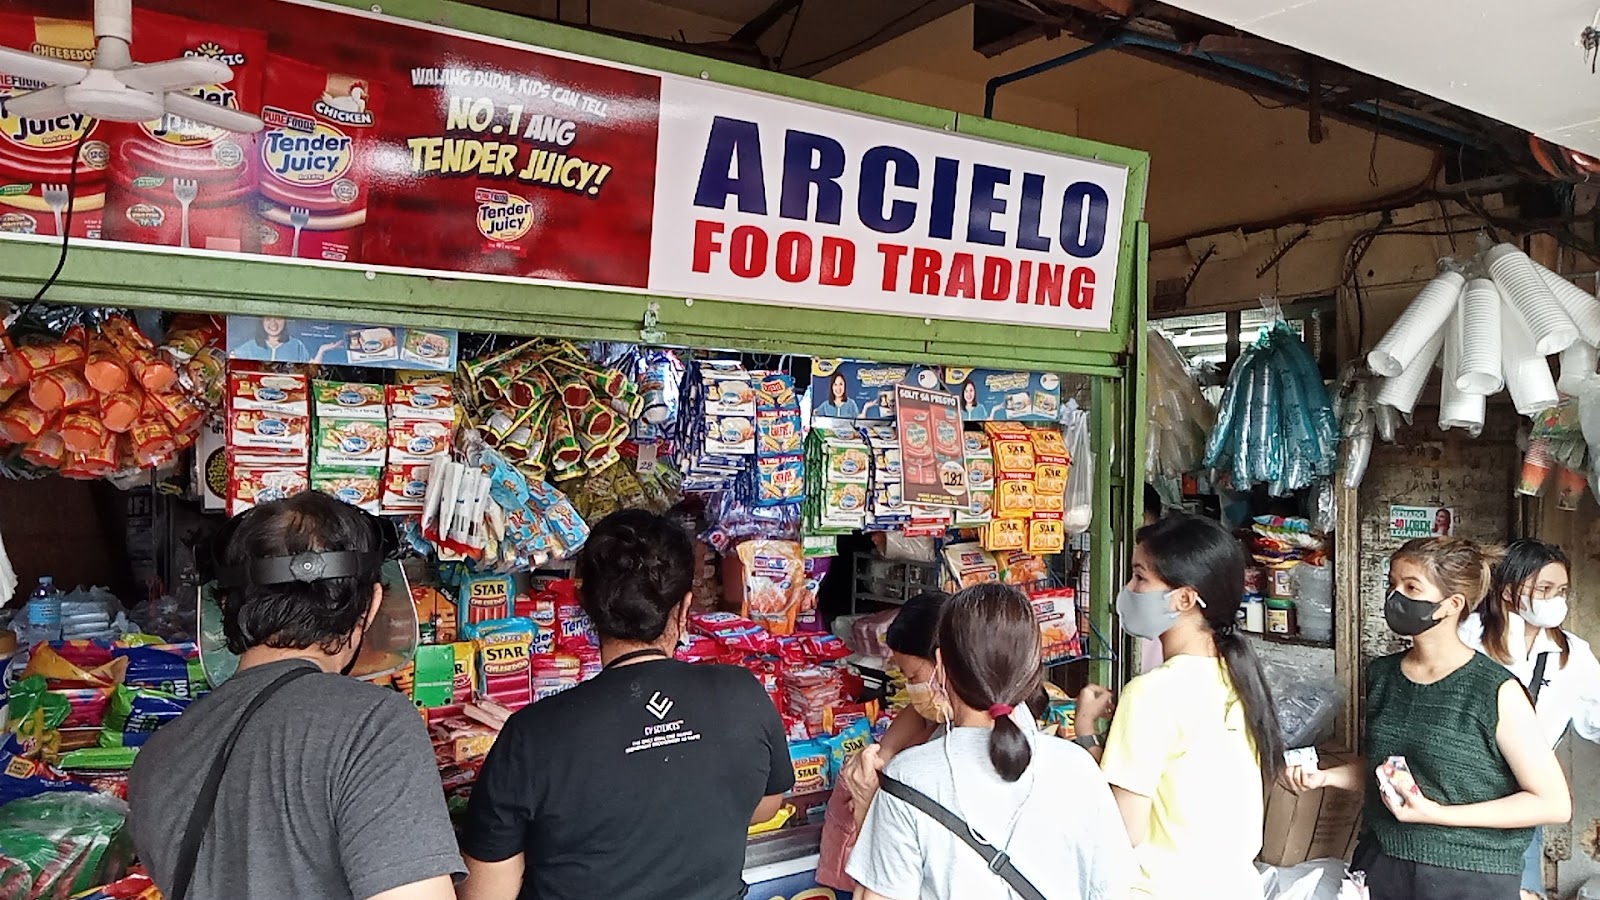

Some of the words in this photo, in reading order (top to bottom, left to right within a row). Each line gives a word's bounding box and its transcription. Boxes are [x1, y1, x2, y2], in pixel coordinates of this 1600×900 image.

[193, 88, 233, 106] der
[411, 68, 470, 86] WALANG
[474, 71, 514, 95] DUDA,
[518, 78, 550, 98] KIDS
[552, 87, 580, 108] CAN
[581, 96, 609, 118] TELL
[264, 111, 315, 131] PUREFOODS
[315, 102, 372, 123] CHICKEN
[524, 116, 576, 146] ANG
[268, 133, 350, 153] Tender
[275, 151, 340, 174] Juicy
[407, 138, 517, 176] TENDER
[518, 150, 612, 195] JUICY!
[693, 115, 1109, 258] ARCIELO
[480, 203, 531, 221] Tender
[487, 217, 525, 234] Juicy
[691, 219, 856, 287] FOOD
[877, 244, 1096, 310] TRADING
[474, 584, 505, 596] STAR
[533, 631, 555, 644] der
[486, 646, 524, 660] STAR
[844, 739, 865, 753] STAR
[797, 767, 818, 778] STAR
